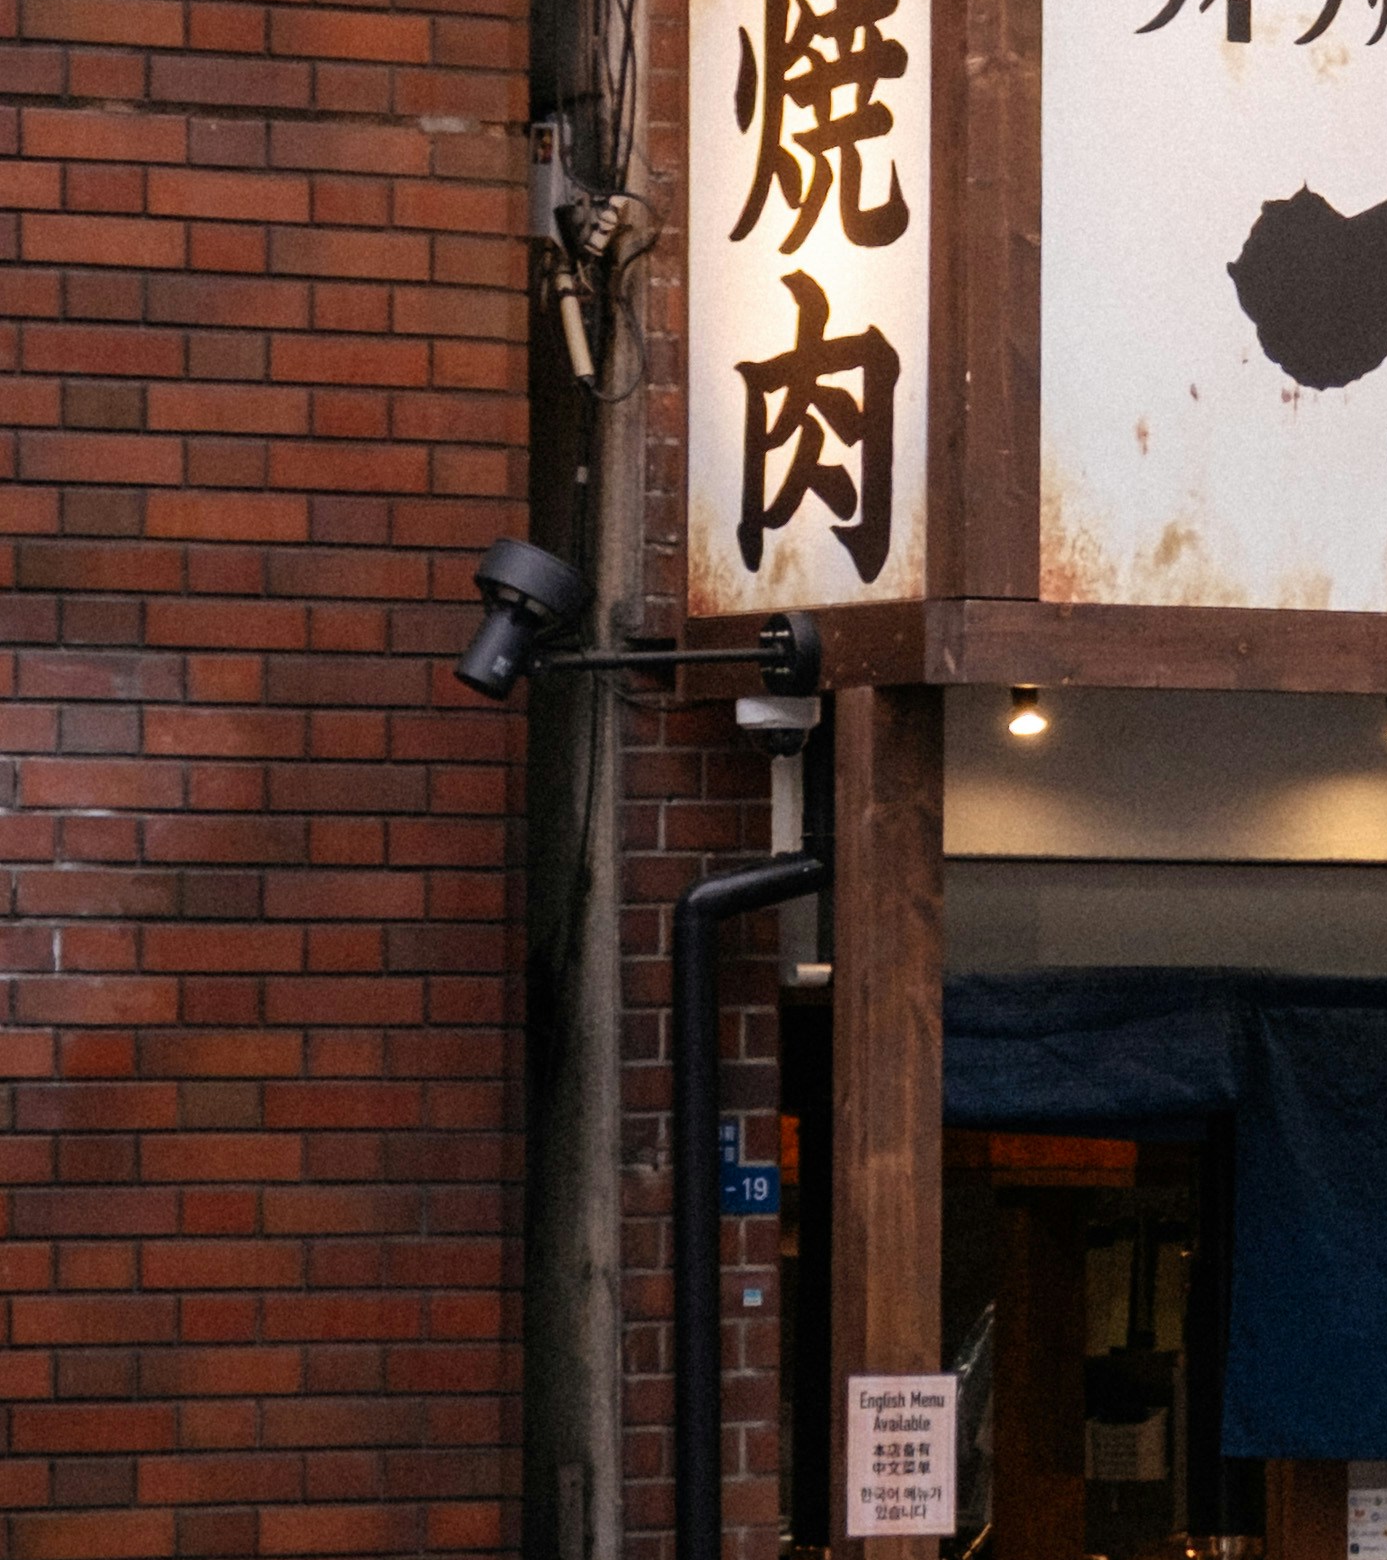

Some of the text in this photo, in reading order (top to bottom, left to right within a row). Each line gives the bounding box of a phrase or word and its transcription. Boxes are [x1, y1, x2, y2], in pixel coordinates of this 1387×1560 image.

[860, 1390, 945, 1413] English Menu
[873, 1414, 931, 1431] Available
